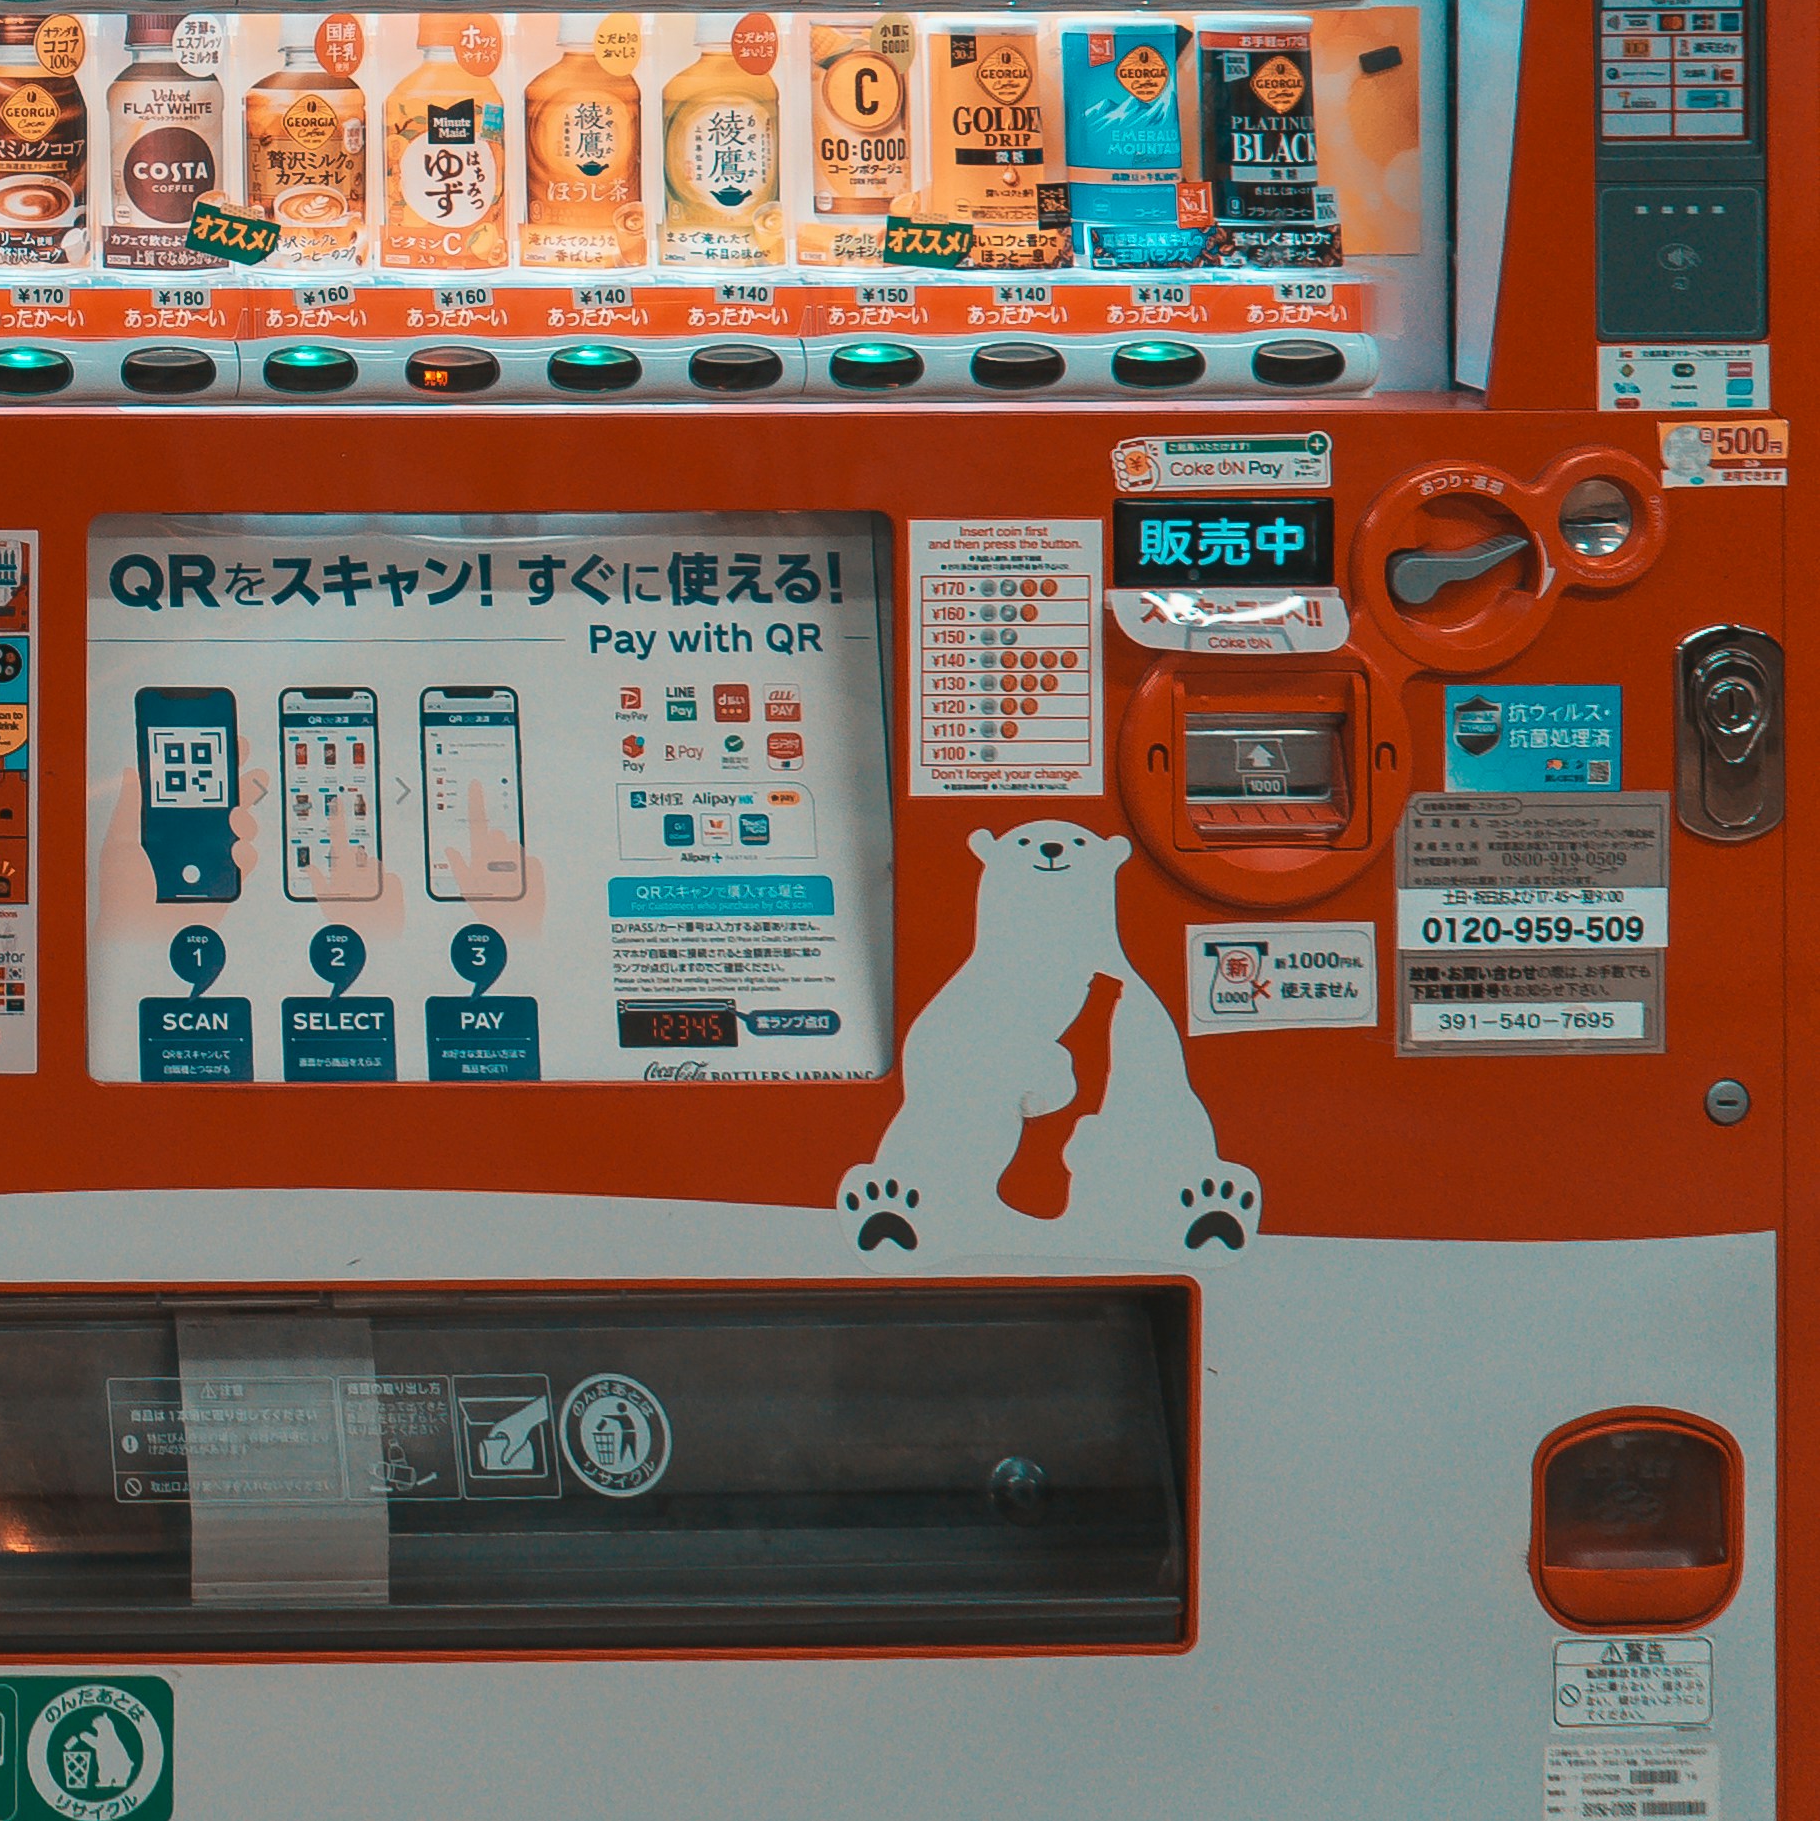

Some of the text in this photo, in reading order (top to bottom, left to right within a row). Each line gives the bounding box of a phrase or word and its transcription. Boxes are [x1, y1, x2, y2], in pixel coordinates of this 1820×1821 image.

[423, 149, 464, 219] ゆず
[192, 213, 279, 252] オススメ!
[1139, 518, 1305, 566] 販売中
[517, 552, 844, 606] すぐに使える!
[589, 622, 823, 660] Pay with QR
[1423, 915, 1644, 944] 0120-959-509
[163, 1012, 229, 1031] SCAN
[293, 1012, 385, 1031] SELECT
